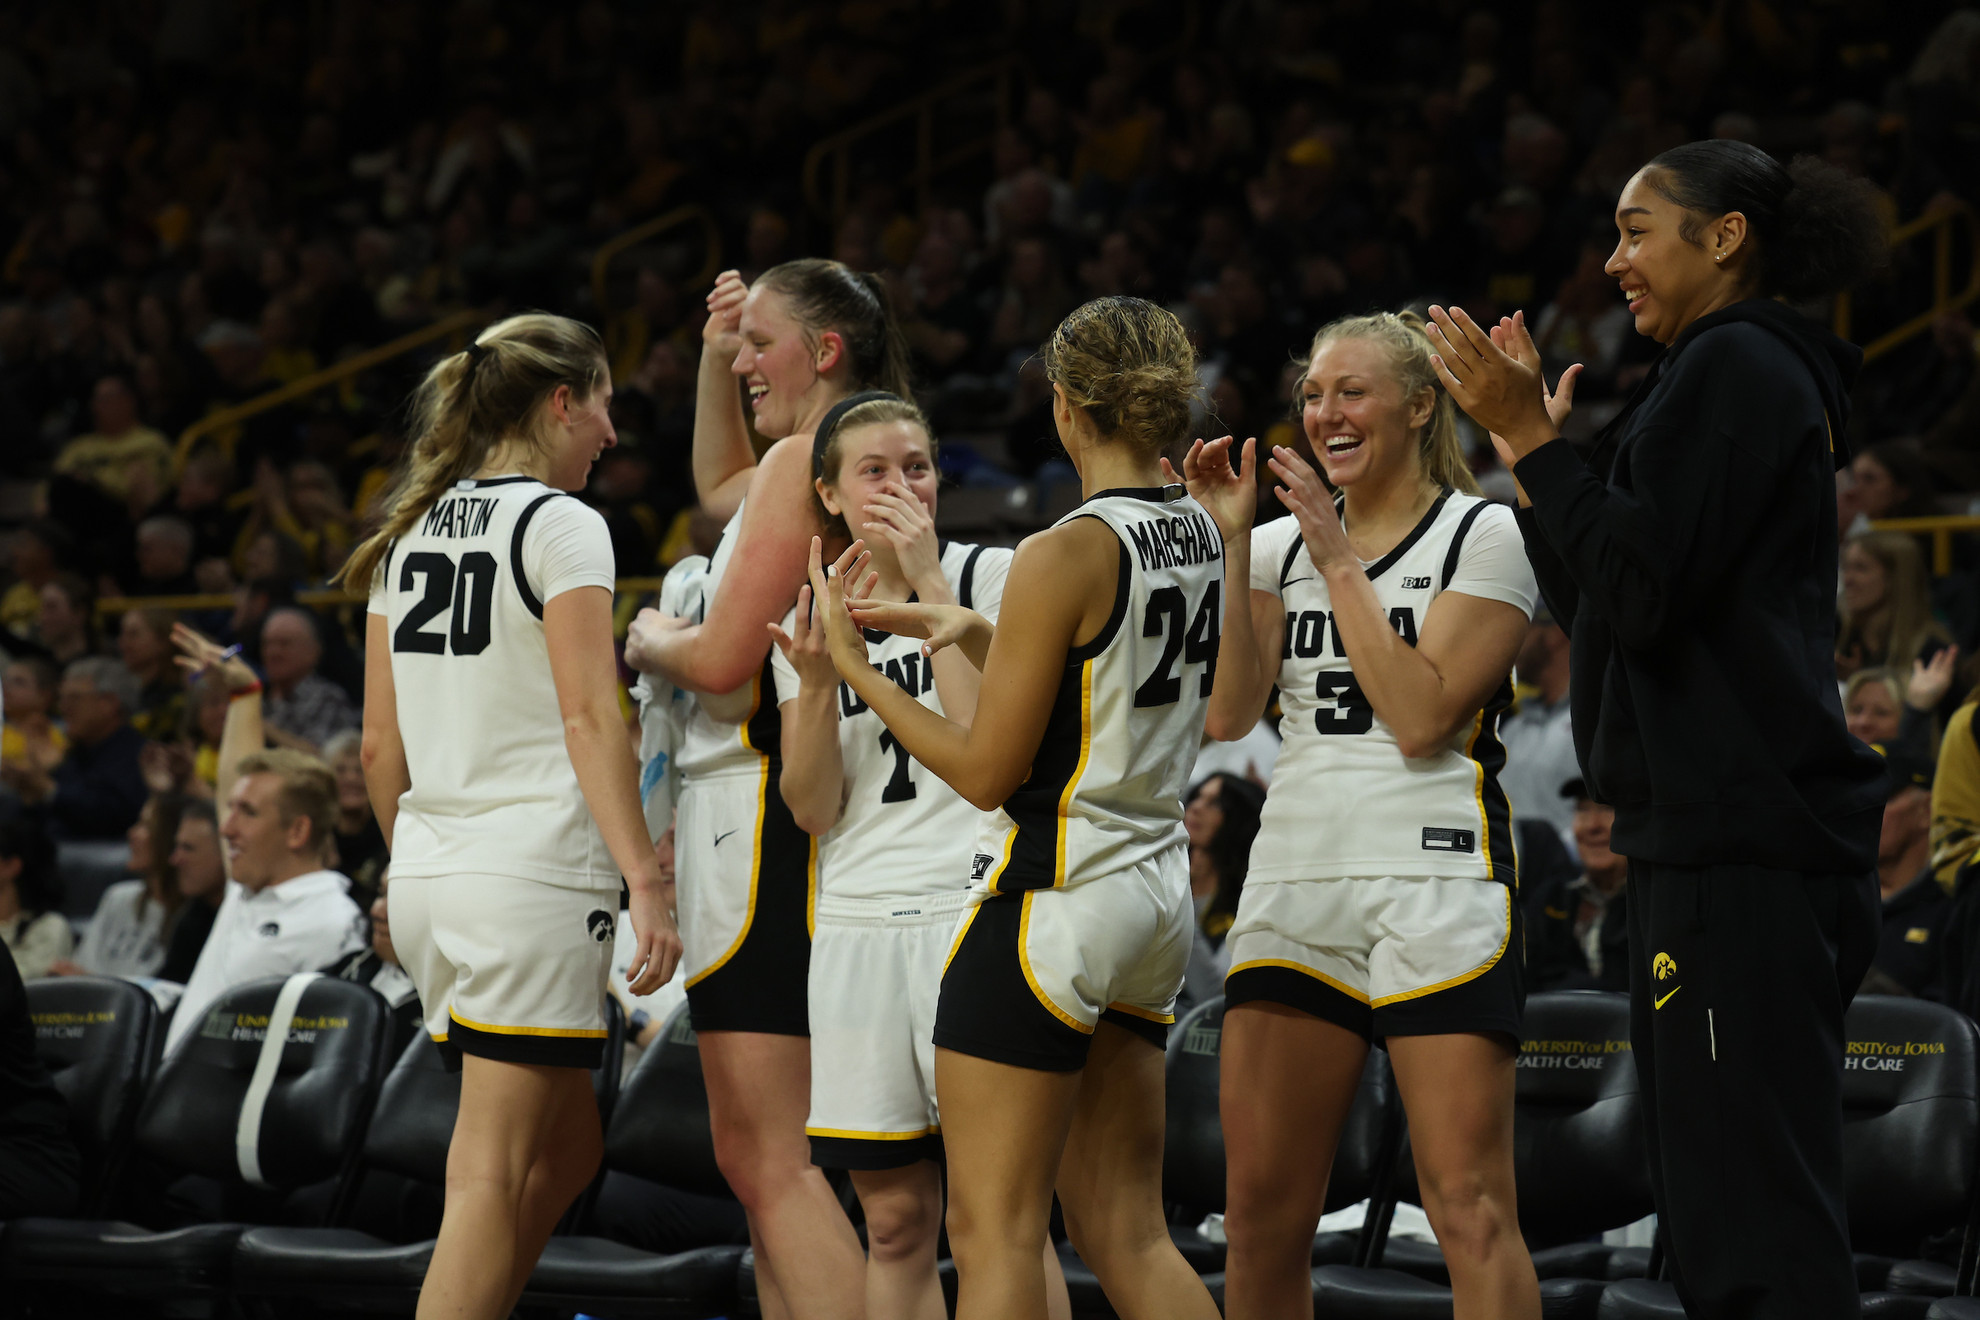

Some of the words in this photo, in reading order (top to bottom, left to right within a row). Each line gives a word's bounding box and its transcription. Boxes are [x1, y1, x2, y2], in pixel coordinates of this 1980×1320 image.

[422, 498, 500, 538] MARTIN
[394, 551, 498, 656] 20
[1134, 579, 1220, 708] 24
[1315, 671, 1374, 735] 3
[1520, 1040, 1586, 1053] NIVERSITY
[1603, 1040, 1632, 1053] IOW
[1903, 1041, 1946, 1055] IOWA
[1515, 1055, 1562, 1068] EALTH
[1564, 1054, 1605, 1069] CARE
[1861, 1056, 1905, 1071] CARE
